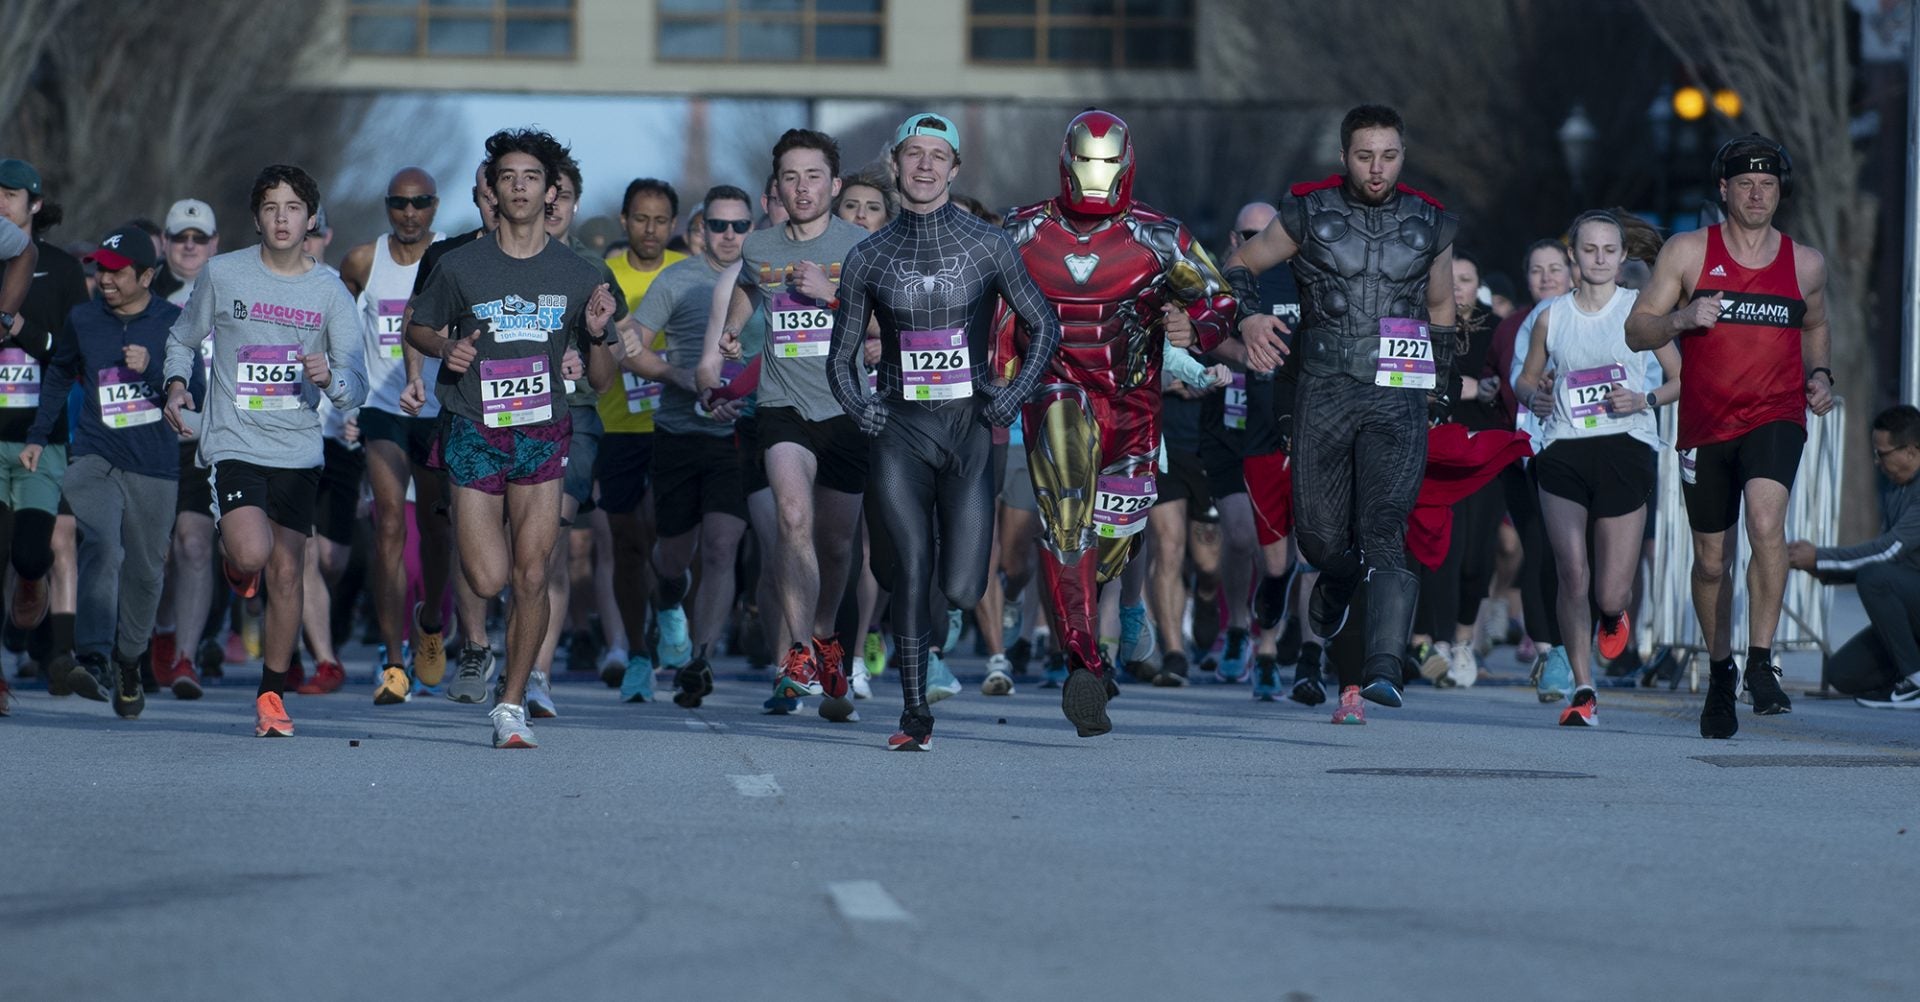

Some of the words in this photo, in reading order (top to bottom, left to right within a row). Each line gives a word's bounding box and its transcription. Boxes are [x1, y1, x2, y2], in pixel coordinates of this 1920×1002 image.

[251, 302, 322, 324] AUGUSTA
[472, 300, 503, 319] TROT
[538, 307, 565, 329] 5K
[1736, 302, 1789, 318] ATLANTA
[1736, 313, 1763, 321] TRACK
[1768, 316, 1789, 324] CLUB
[499, 315, 538, 330] ADOPT
[778, 311, 828, 330] 1336
[501, 332, 517, 340] 10th
[518, 331, 543, 339] Annual
[1388, 339, 1429, 359] 1227
[909, 350, 964, 371] 1226
[246, 364, 296, 382] 1365
[107, 382, 154, 402] 1423
[490, 376, 544, 398] 1245
[1577, 382, 1623, 404] 122
[1102, 493, 1151, 513] 1228
